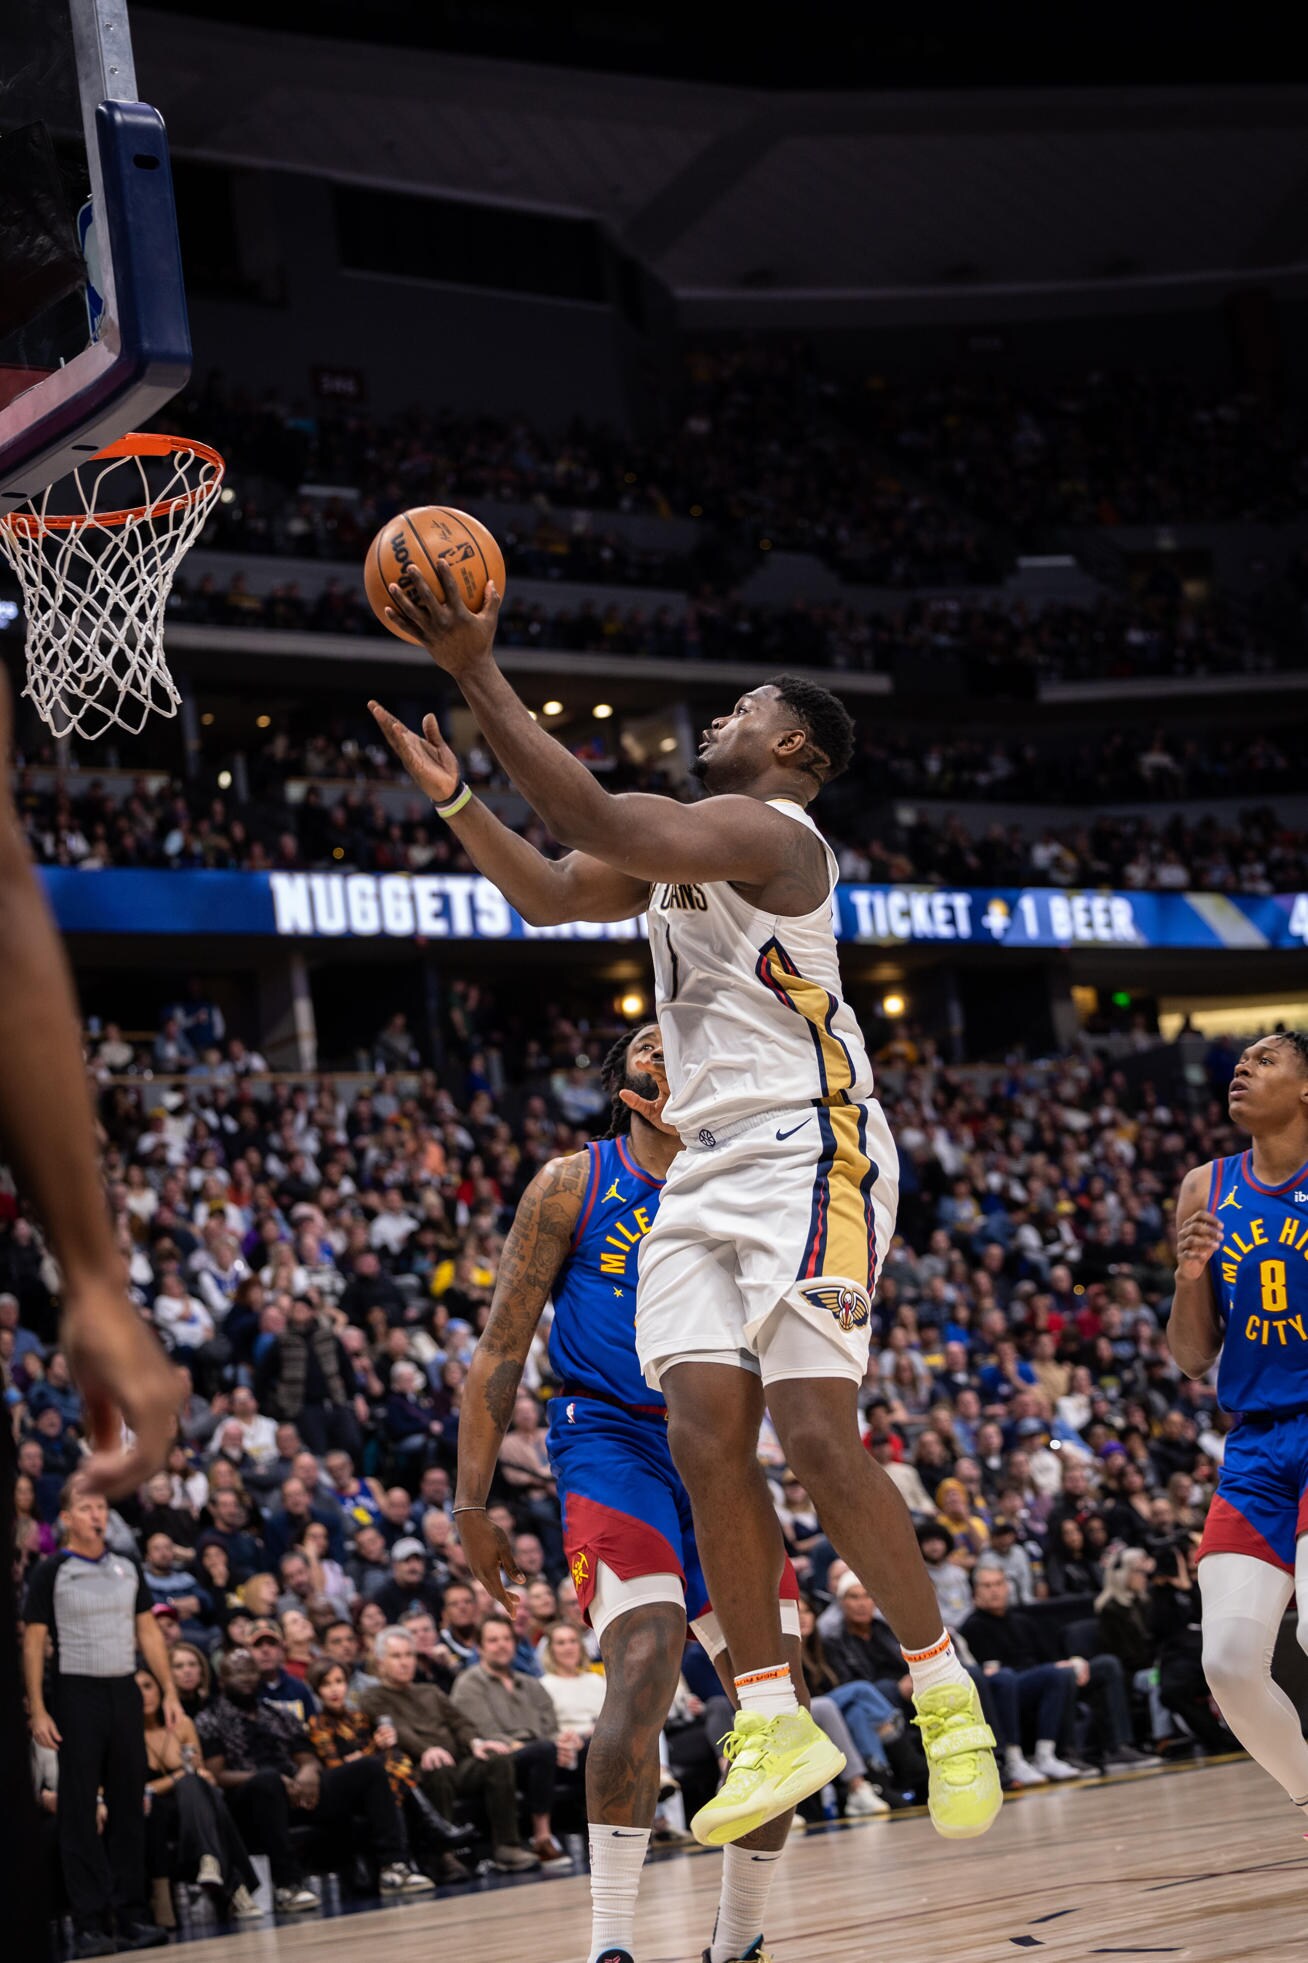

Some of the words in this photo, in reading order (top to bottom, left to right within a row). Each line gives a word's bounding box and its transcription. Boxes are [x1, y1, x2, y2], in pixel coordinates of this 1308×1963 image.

[269, 872, 512, 937] NUGGETS
[850, 890, 972, 939] TICKET
[1018, 894, 1040, 940] 1
[1048, 894, 1137, 941] BEER
[1294, 1191, 1308, 1202] ib
[600, 1207, 652, 1275] MILE
[1221, 1218, 1270, 1284] MILE
[1259, 1259, 1288, 1313] 8
[1245, 1314, 1308, 1346] CITY
